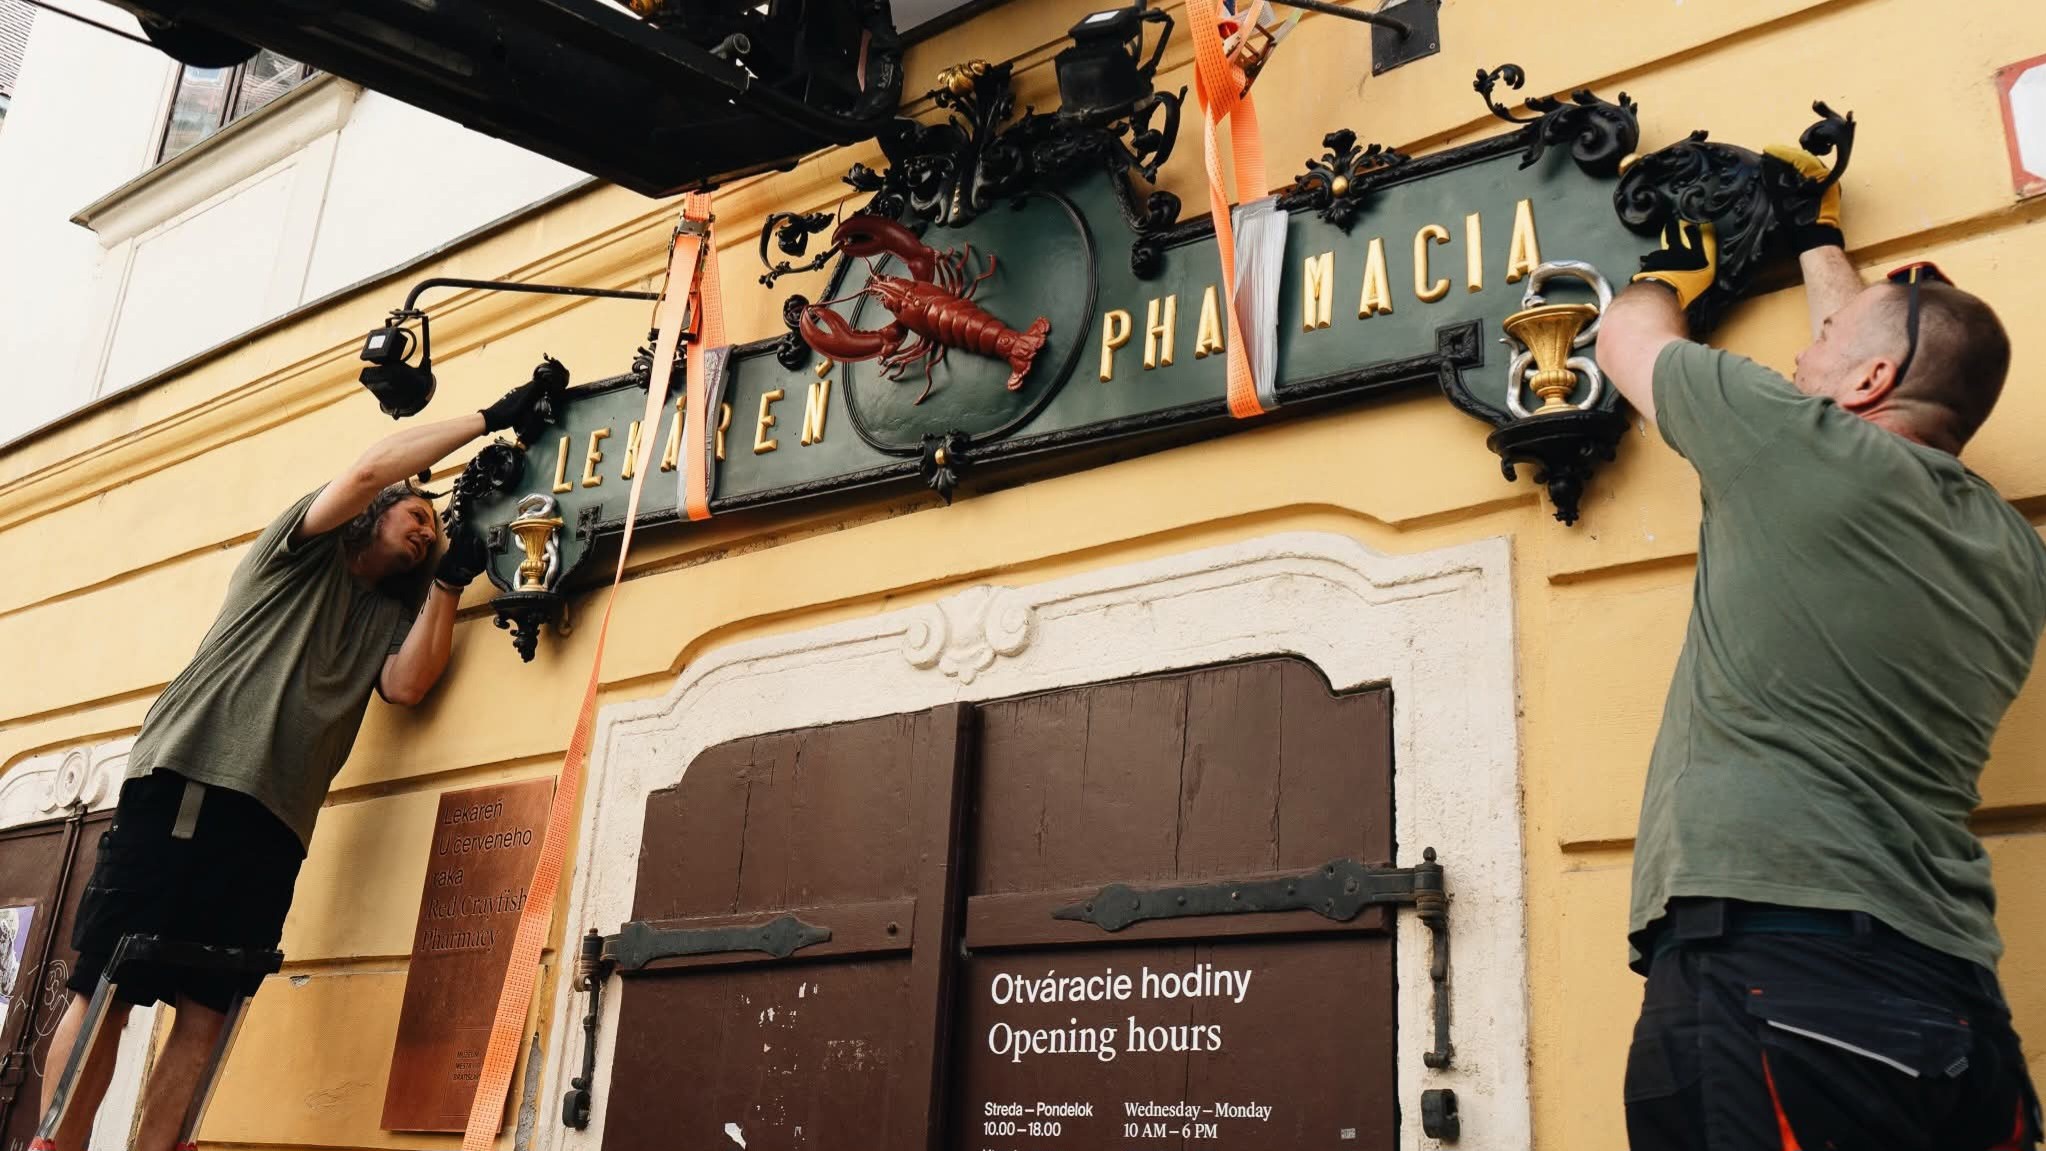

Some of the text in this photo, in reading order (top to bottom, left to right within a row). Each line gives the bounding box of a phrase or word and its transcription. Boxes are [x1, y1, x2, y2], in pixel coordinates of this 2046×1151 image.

[1100, 198, 1541, 383] PHAMACIA
[444, 799, 503, 825] Lekáreň
[439, 828, 532, 856] U červeného
[432, 867, 464, 888] raka
[427, 887, 528, 921] Red Crayfish
[422, 927, 499, 952] Pharmacy
[991, 964, 1252, 1005] Otváracie hodiny
[988, 1016, 1222, 1063] Opening hours
[984, 1101, 1023, 1117] Streda
[1036, 1101, 1094, 1117] Pondelok
[1124, 1100, 1201, 1121] Wednesday
[1215, 1101, 1272, 1122] Monday
[1124, 1122, 1139, 1138] 10
[1141, 1122, 1167, 1138] AM
[1182, 1122, 1191, 1138] 6
[1194, 1123, 1218, 1139] PM
